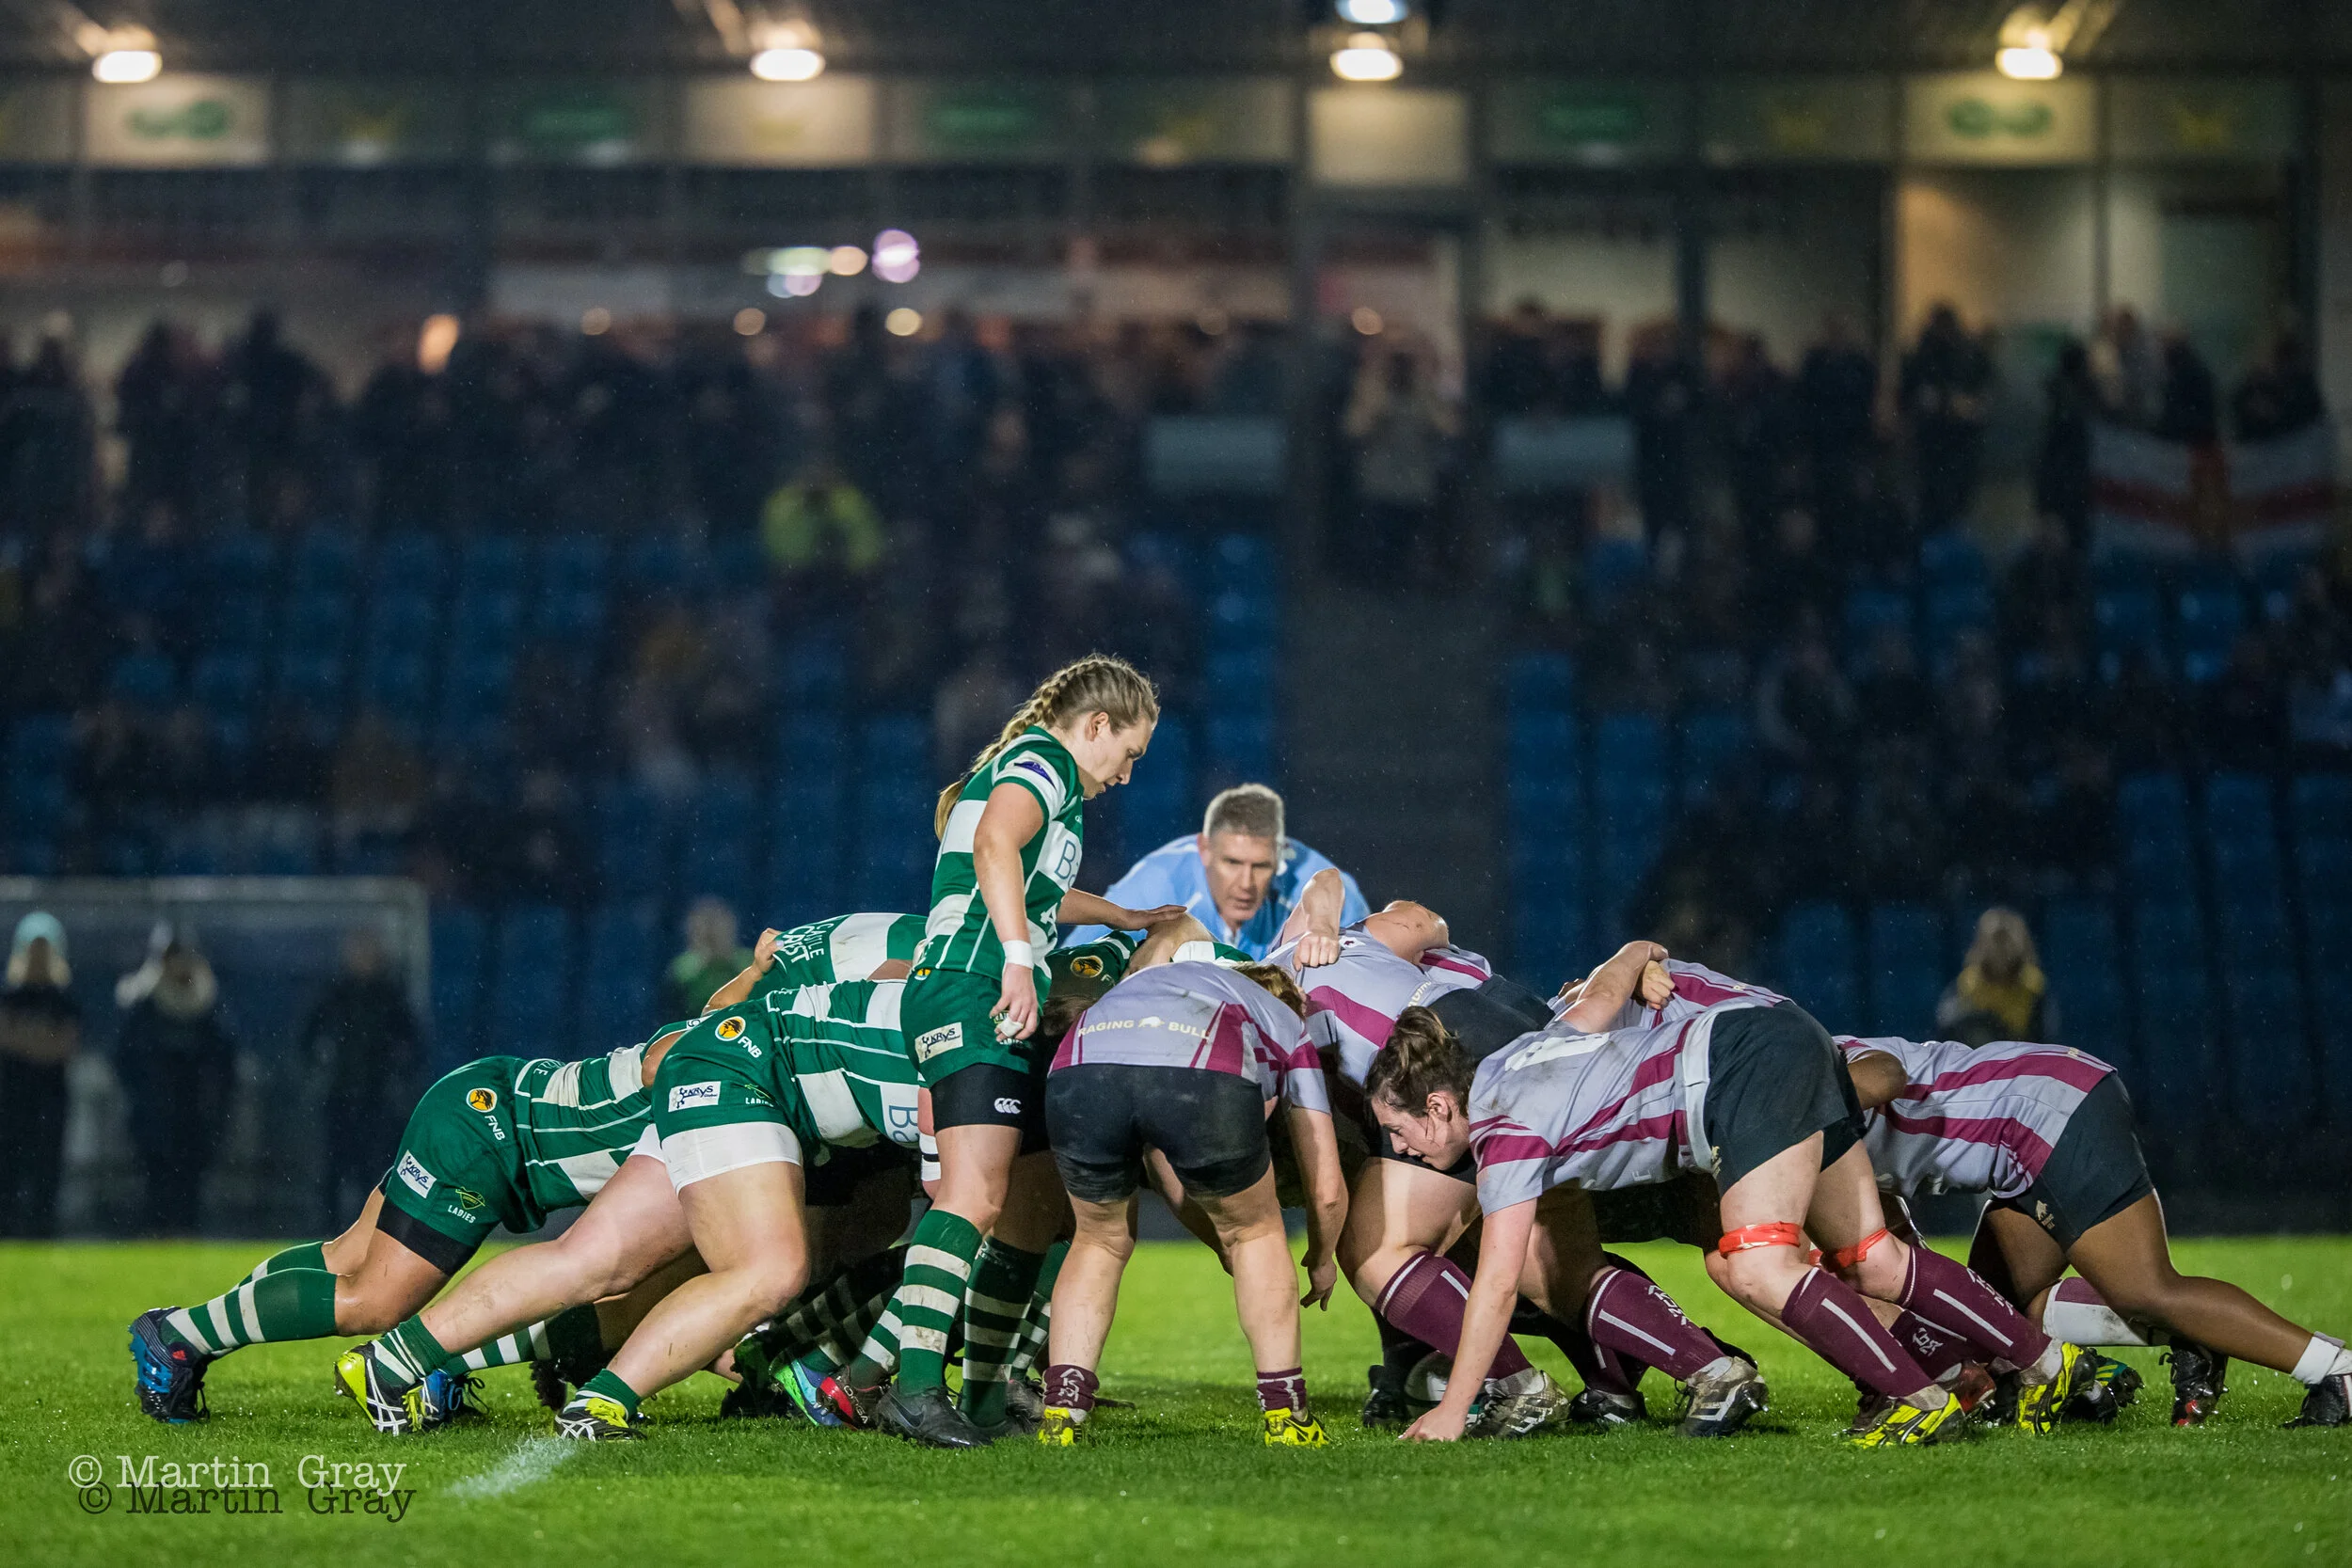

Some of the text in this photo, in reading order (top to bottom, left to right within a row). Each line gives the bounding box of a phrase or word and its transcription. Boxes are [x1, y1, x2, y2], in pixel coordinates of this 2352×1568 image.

[1077, 1020, 1210, 1040] RAGING BULL
[738, 1036, 763, 1058] FNB
[485, 1115, 506, 1141] FNB
[447, 1205, 476, 1224] LADIES
